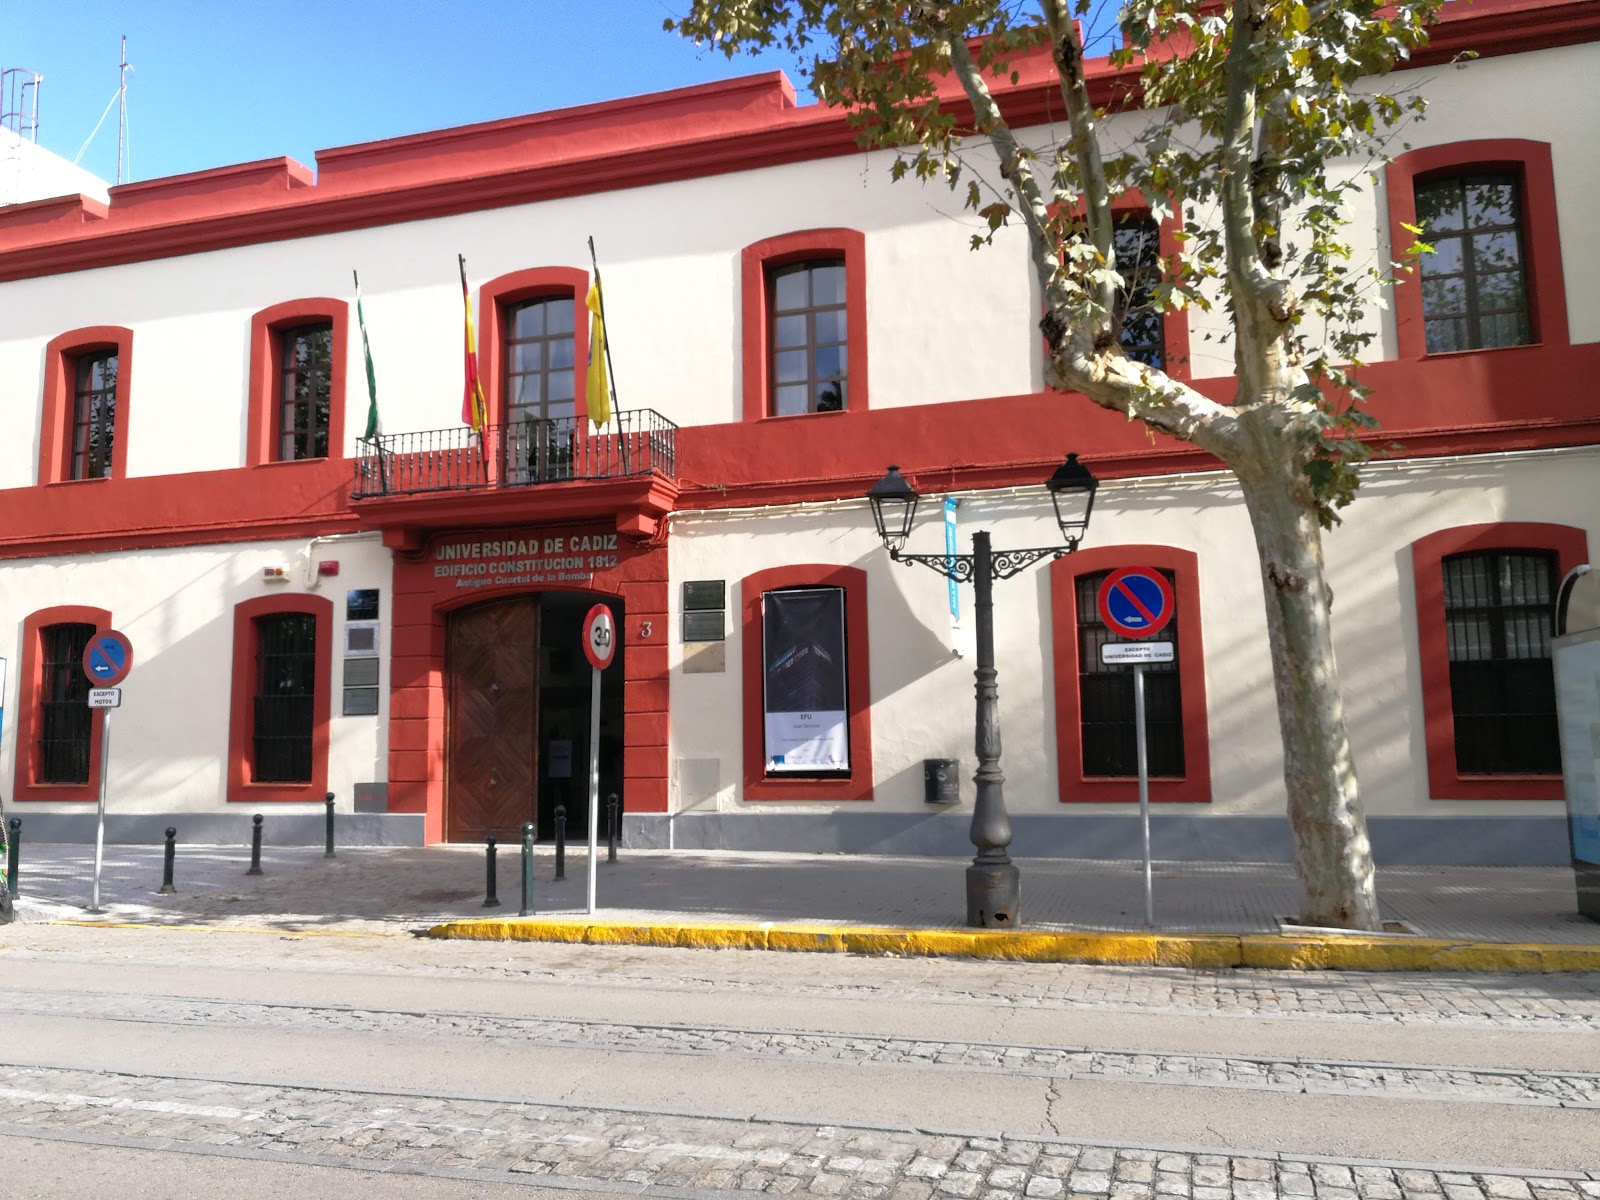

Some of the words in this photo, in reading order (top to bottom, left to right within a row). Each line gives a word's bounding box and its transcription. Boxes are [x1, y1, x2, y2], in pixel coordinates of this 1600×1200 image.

[436, 539, 539, 560] UNIVERSIDAD
[544, 537, 564, 554] DE
[569, 534, 618, 552] CADIZ
[434, 562, 487, 577] EDIFICIO
[489, 556, 584, 574] CONSTITUCION
[588, 555, 618, 569] 1812
[456, 577, 492, 587] Antiguo
[495, 574, 530, 584] Cuartel
[532, 573, 544, 582] de
[547, 573, 556, 582] la
[558, 571, 592, 582] Bomba
[594, 626, 611, 648] 30
[641, 621, 652, 638] 3
